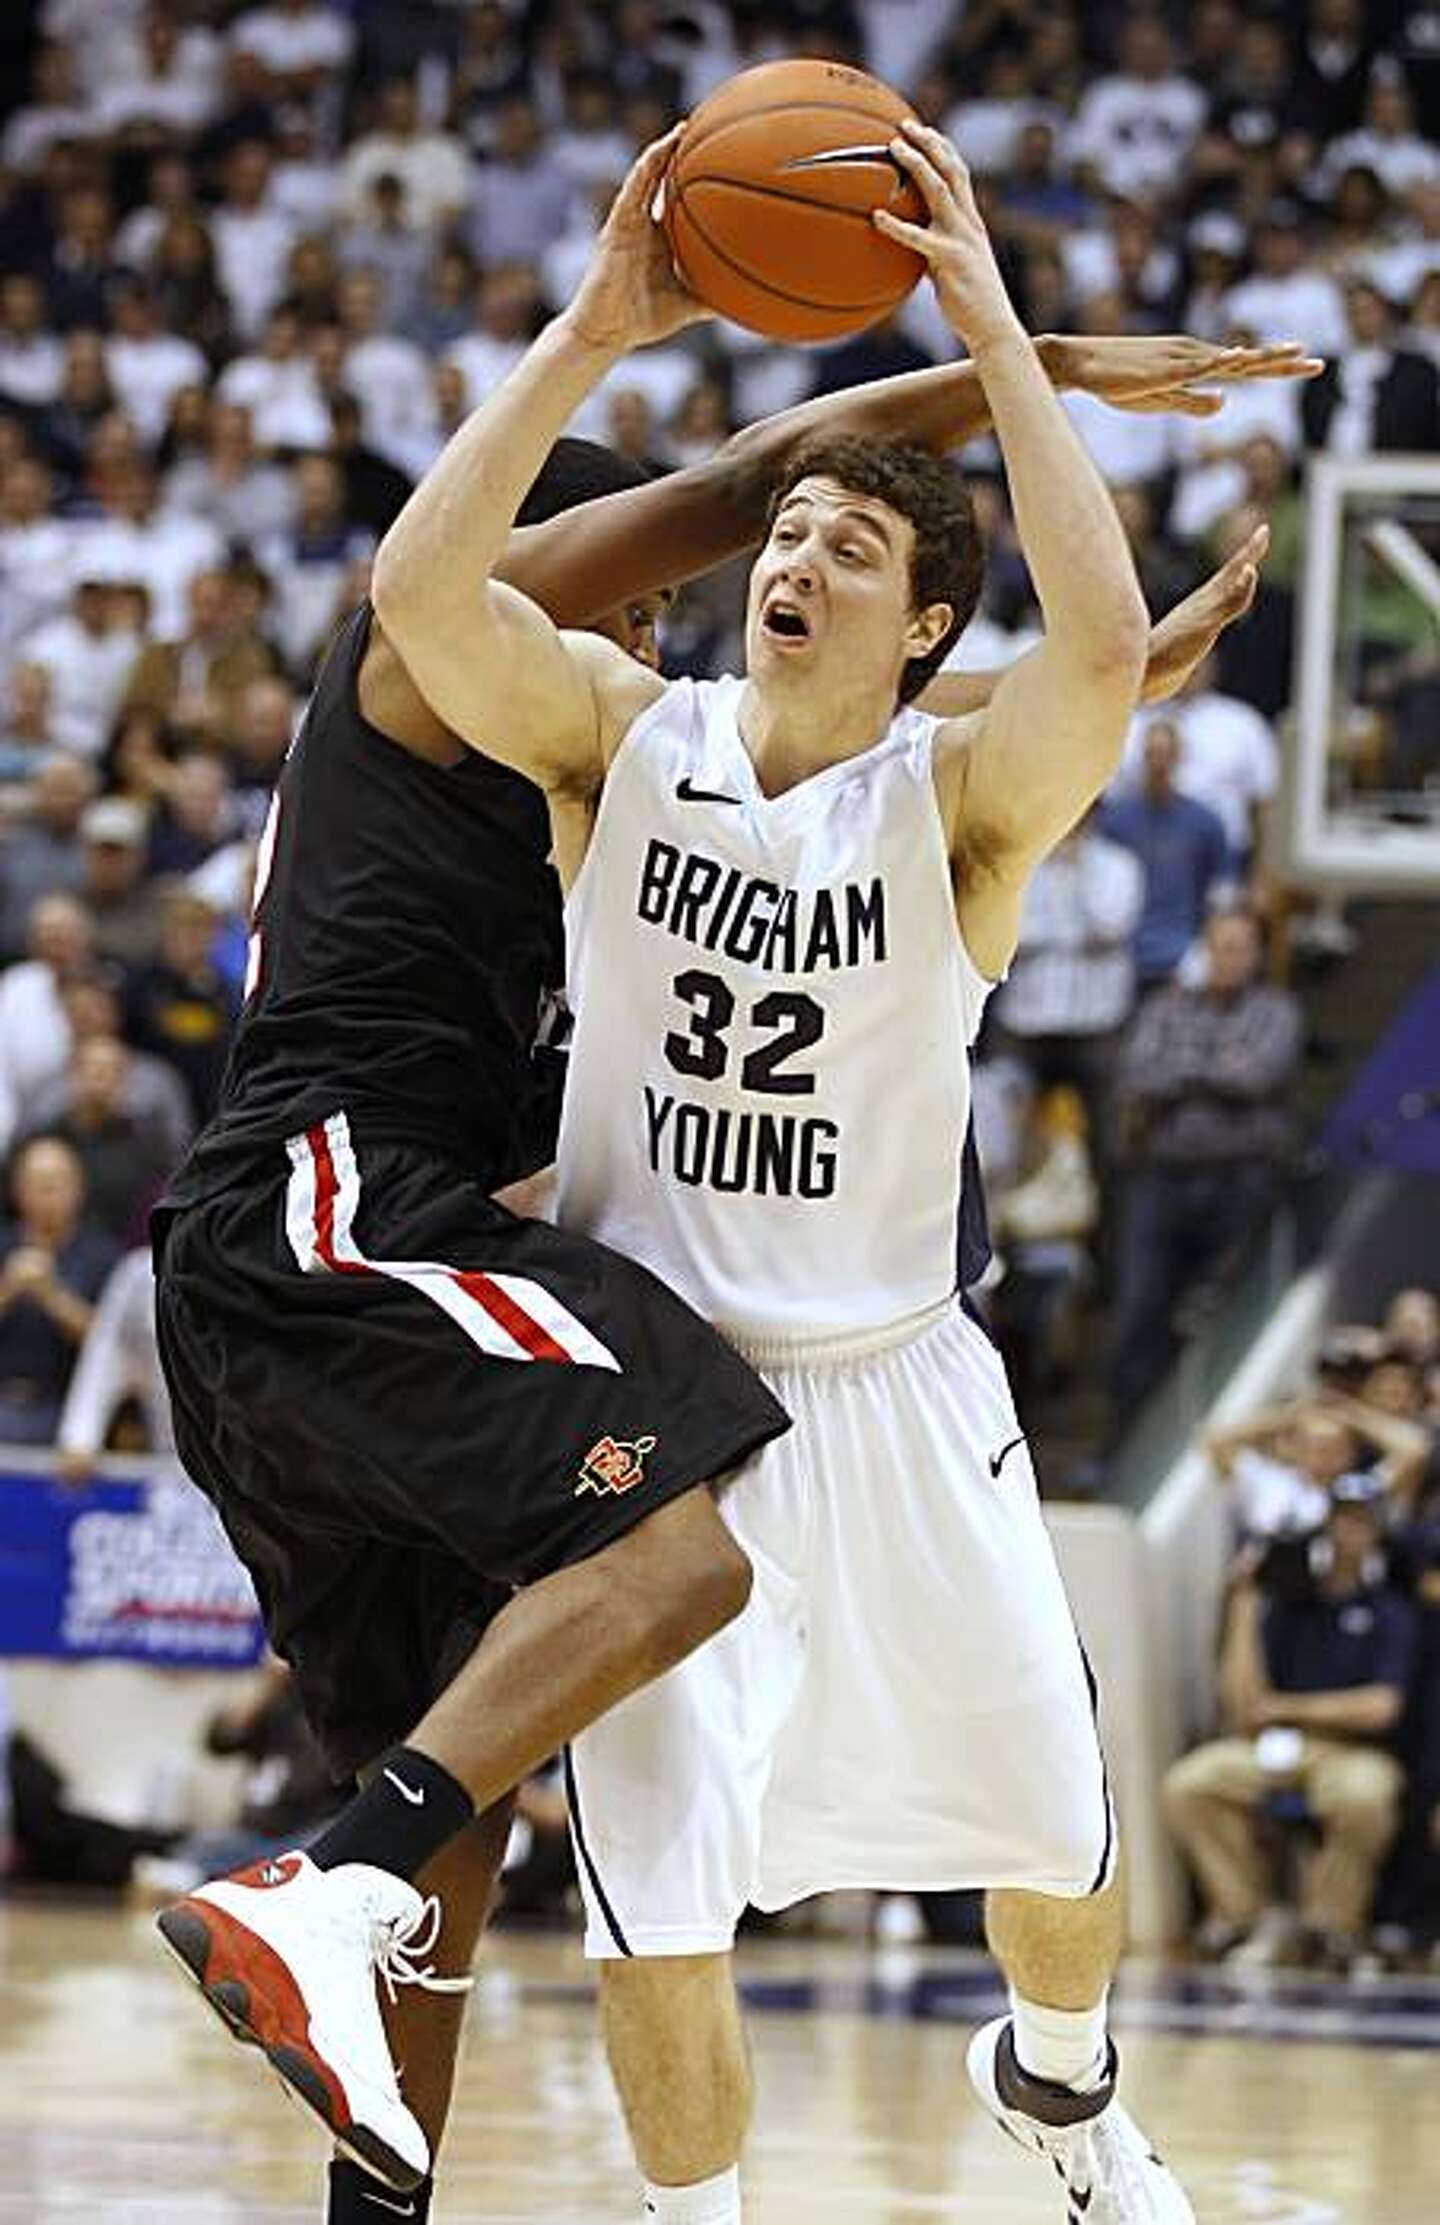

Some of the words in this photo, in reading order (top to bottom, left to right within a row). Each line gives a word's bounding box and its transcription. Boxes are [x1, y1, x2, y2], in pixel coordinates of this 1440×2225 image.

[638, 839, 885, 973] BRIGHAM
[664, 969, 825, 1094] 32
[644, 1086, 839, 1199] YOUNG
